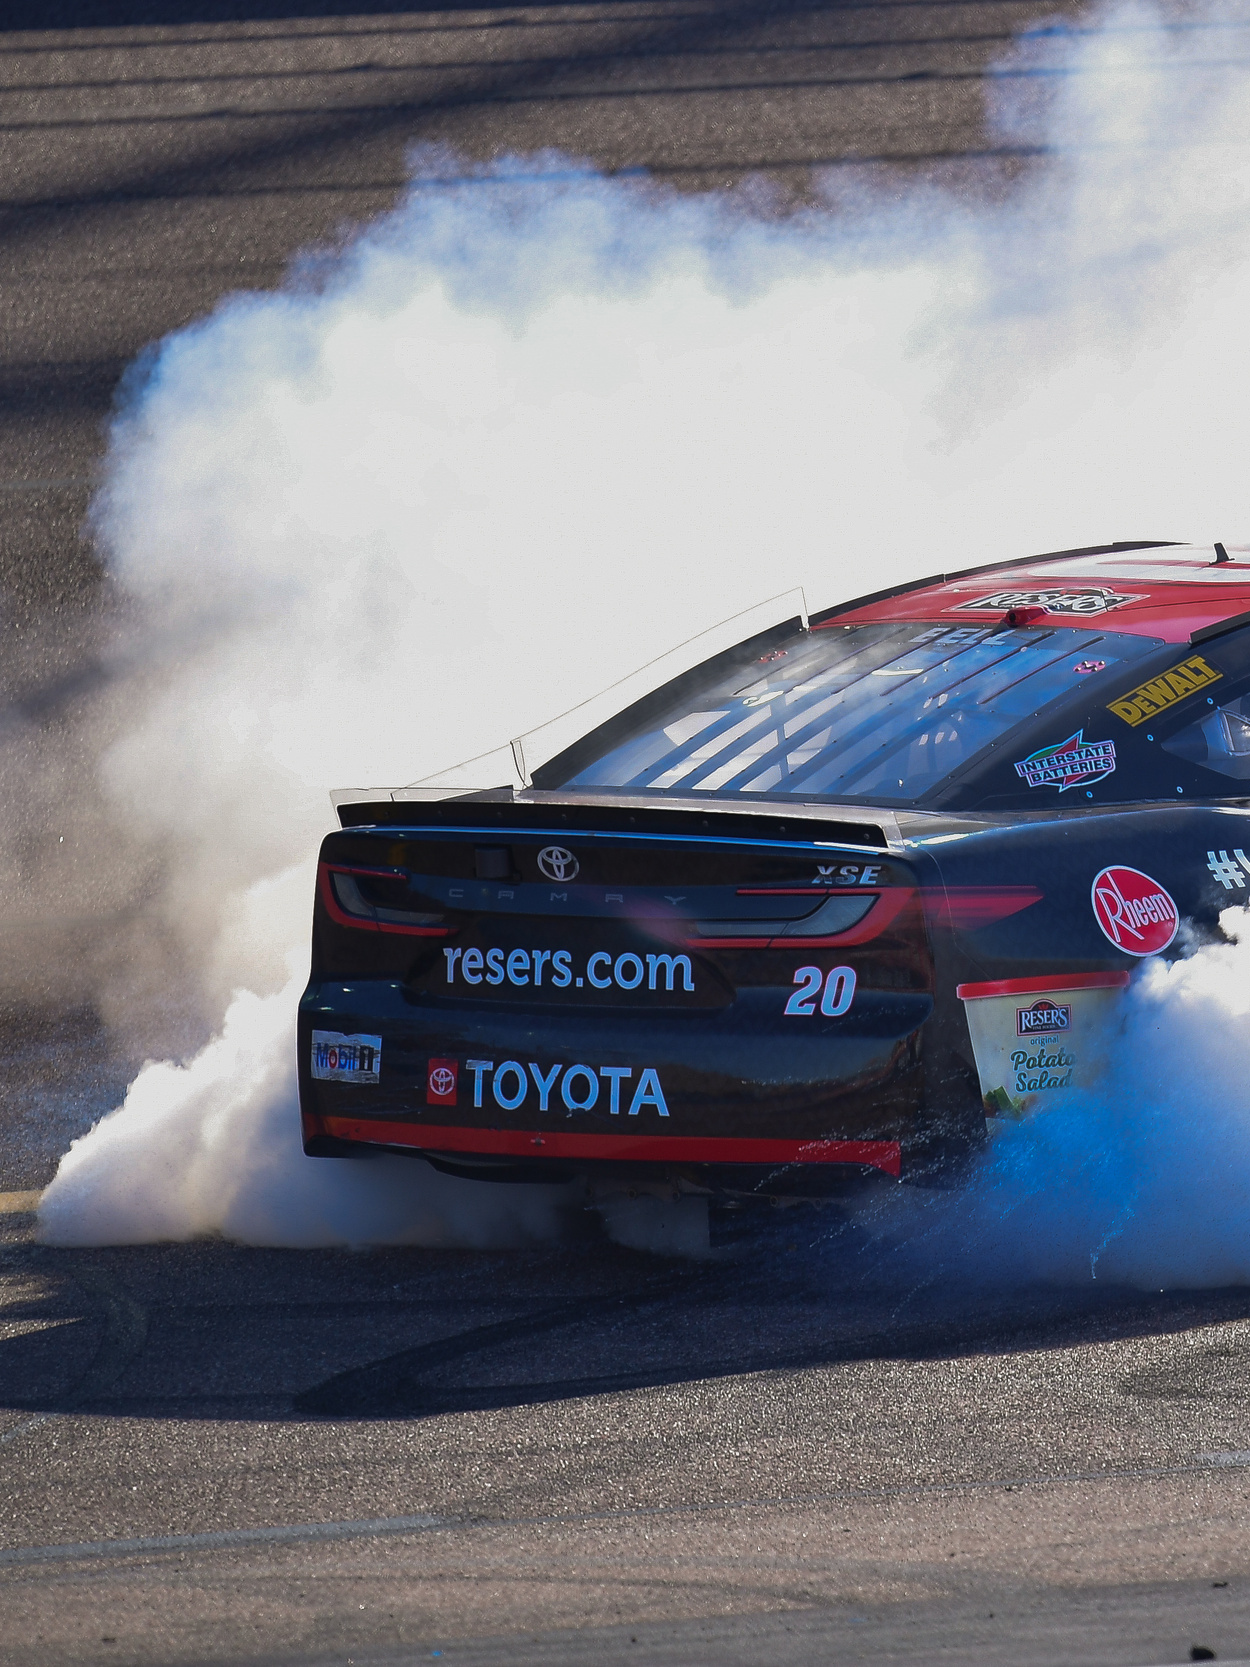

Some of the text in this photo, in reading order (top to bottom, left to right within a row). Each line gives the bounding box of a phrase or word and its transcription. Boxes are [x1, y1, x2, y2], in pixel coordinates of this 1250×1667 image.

[1019, 743, 1113, 774] INTERSTATE
[1031, 758, 1112, 784] BATTERIES
[811, 865, 882, 885] XSE
[449, 888, 687, 905] CAMRY
[1096, 871, 1175, 942] Rheem
[442, 947, 695, 992] resers.com
[783, 965, 857, 1017] 20
[1021, 1008, 1067, 1032] RESER'S
[1030, 1035, 1059, 1047] original
[315, 1042, 357, 1071] Mobil
[1010, 1047, 1076, 1072] Potato
[465, 1058, 670, 1118] TOYOTA
[1015, 1068, 1073, 1093] Salad
